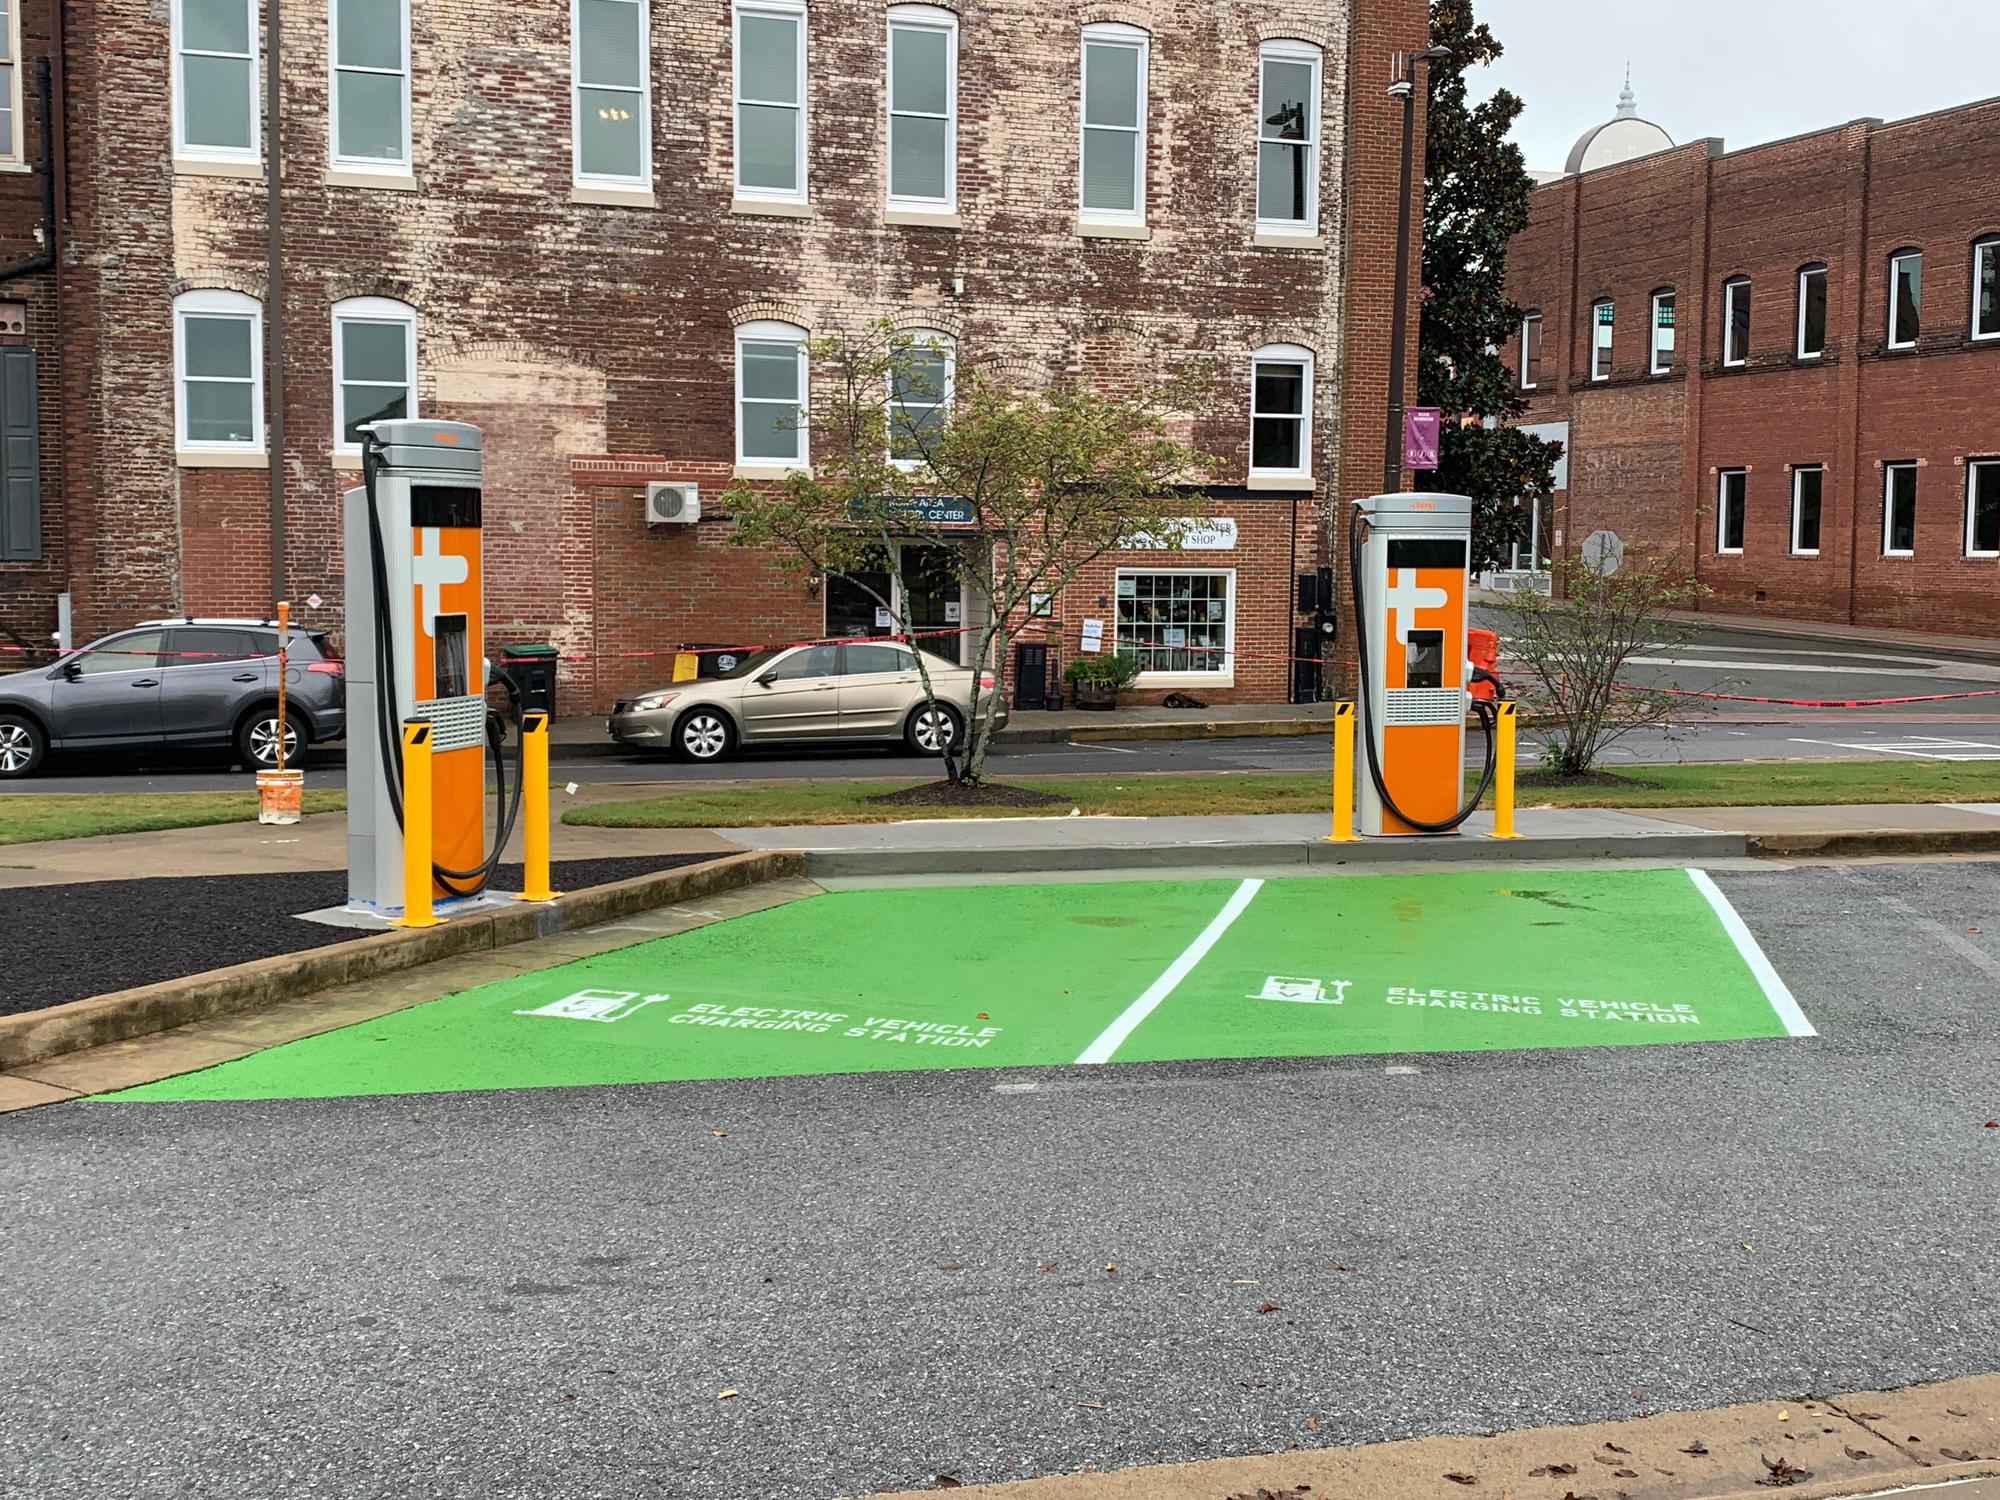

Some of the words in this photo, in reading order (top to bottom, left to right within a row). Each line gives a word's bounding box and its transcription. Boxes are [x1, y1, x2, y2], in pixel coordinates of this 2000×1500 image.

[928, 510, 964, 520] CENTER
[1191, 534, 1217, 545] SHOP
[1386, 996, 1542, 1015] CHARGING
[1560, 1007, 1700, 1025] STATION
[1388, 987, 1540, 1006] ELECTRIC
[1557, 998, 1695, 1014] VEHICLE
[667, 1014, 832, 1033] CHARGING
[843, 1027, 991, 1048] STATION
[687, 1003, 849, 1023] ELECTRIC
[864, 1017, 1003, 1037] VEHICLE
